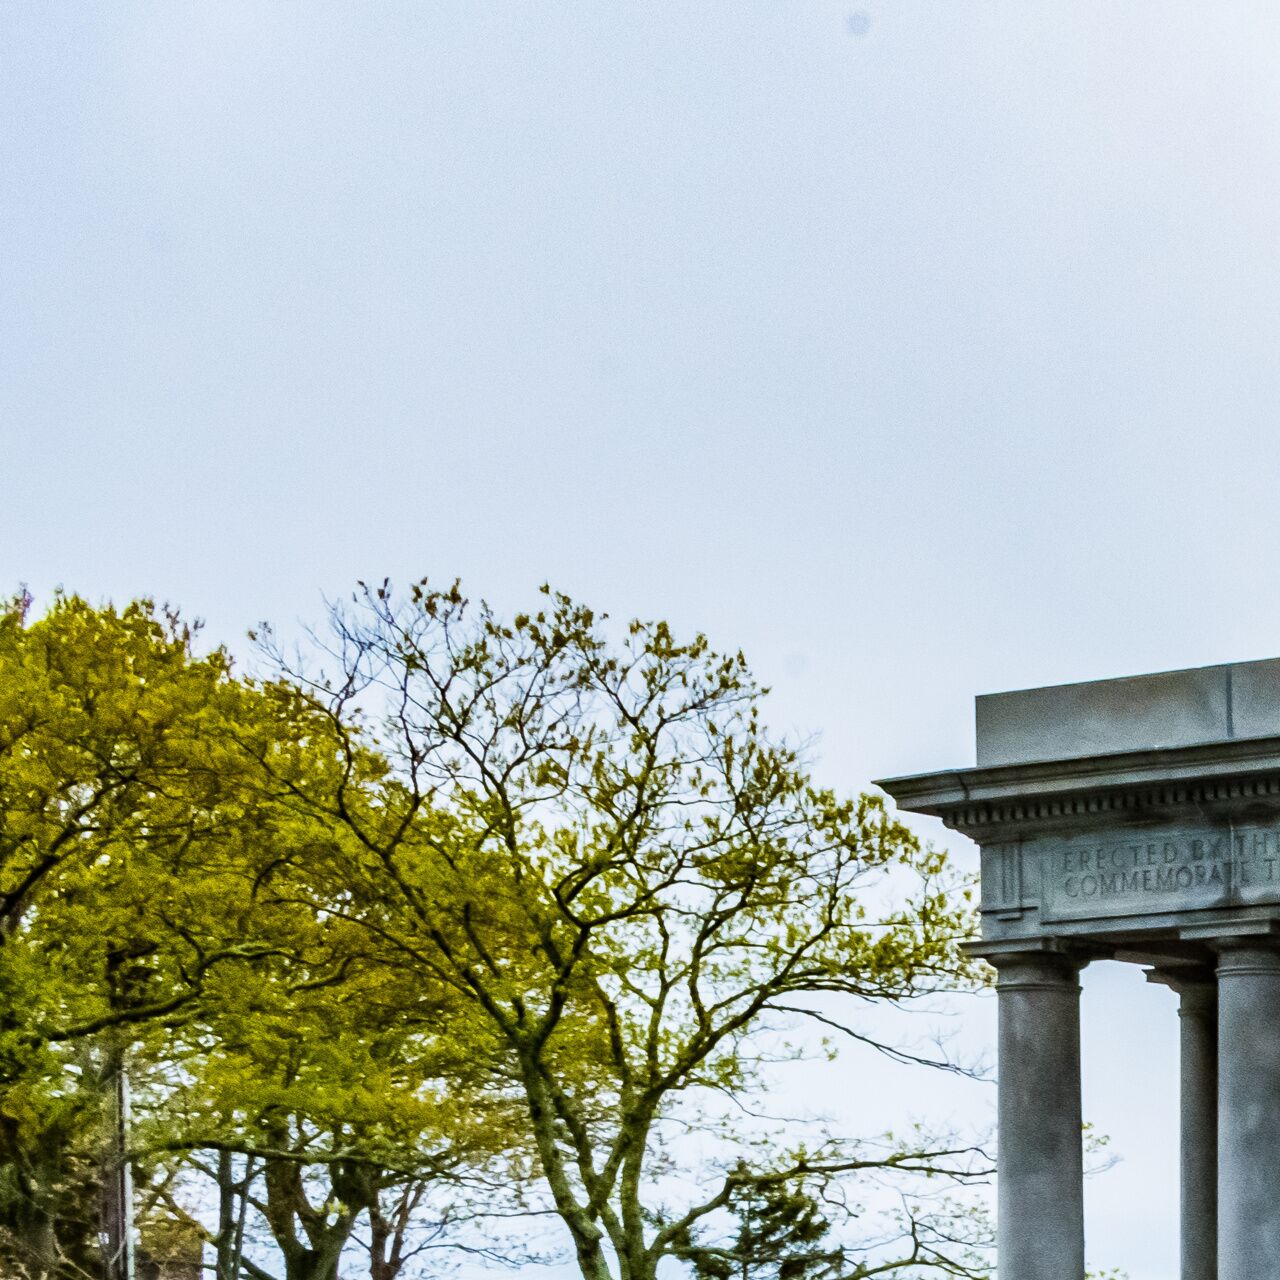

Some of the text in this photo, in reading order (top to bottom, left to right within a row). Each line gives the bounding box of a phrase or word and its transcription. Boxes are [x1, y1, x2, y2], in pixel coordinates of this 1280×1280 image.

[1062, 842, 1178, 872] ERECTED
[1192, 838, 1224, 862] BY
[1064, 861, 1250, 898] COMMEMORATE
